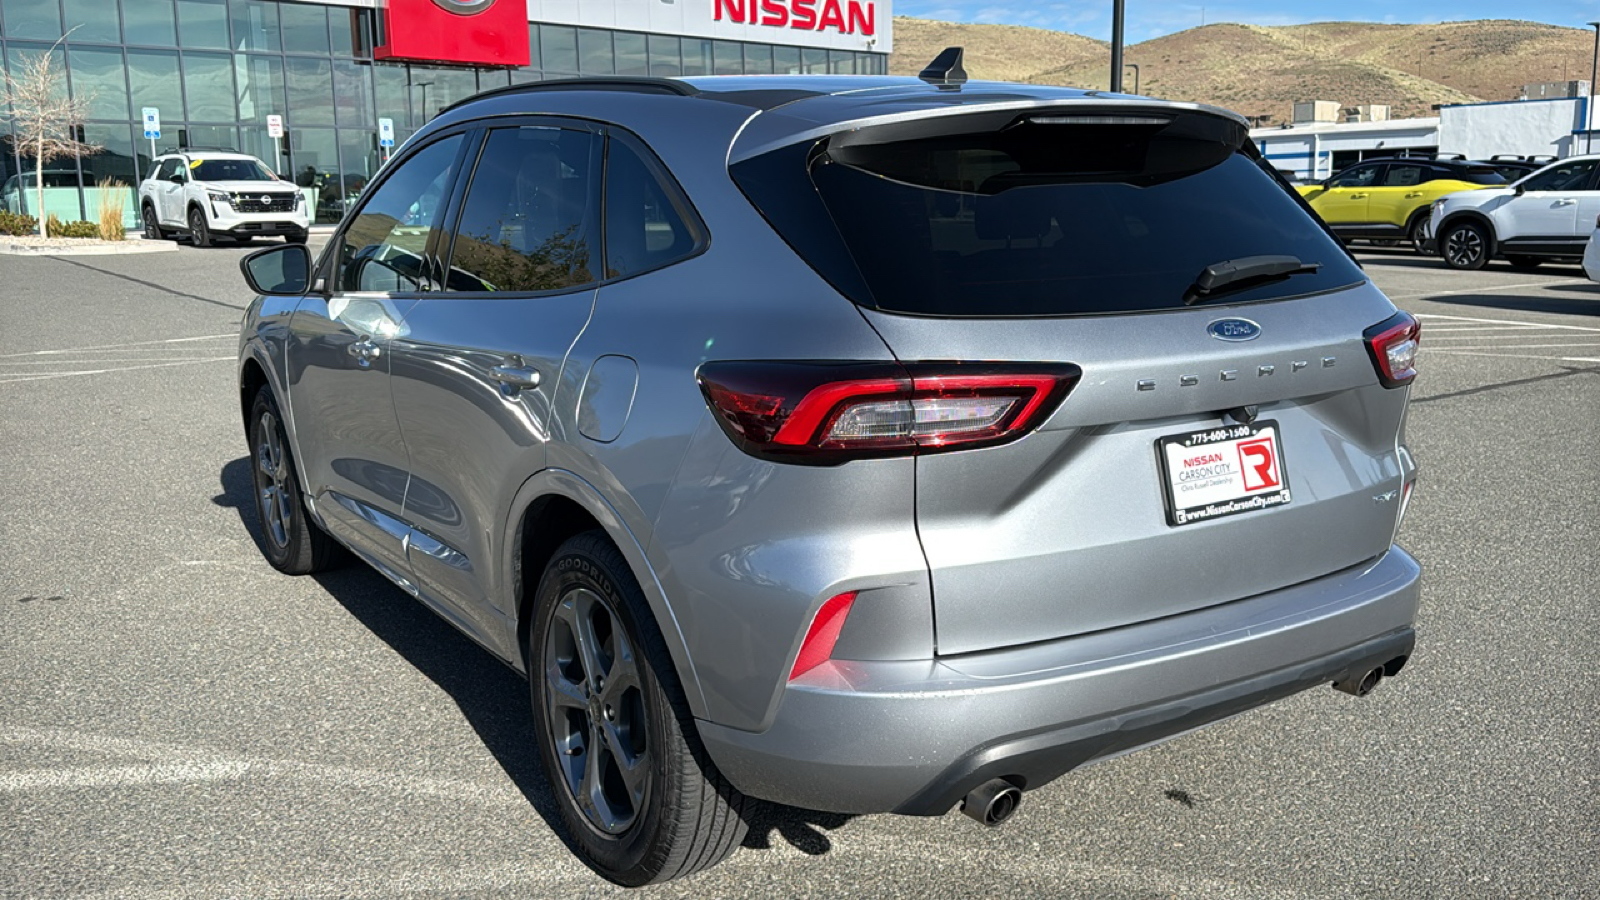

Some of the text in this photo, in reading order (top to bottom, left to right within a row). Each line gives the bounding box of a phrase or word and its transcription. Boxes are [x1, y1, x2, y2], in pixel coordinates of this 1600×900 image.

[713, 0, 876, 36] NISSAN
[1136, 356, 1336, 391] ESCAPE
[1191, 425, 1250, 445] 775-600-1500
[1179, 462, 1231, 482] CARSON CITY
[1183, 452, 1223, 468] NISSAN
[1186, 494, 1281, 521] www.NissanCarsonCity.com
[558, 558, 621, 607] GOODRIDE
